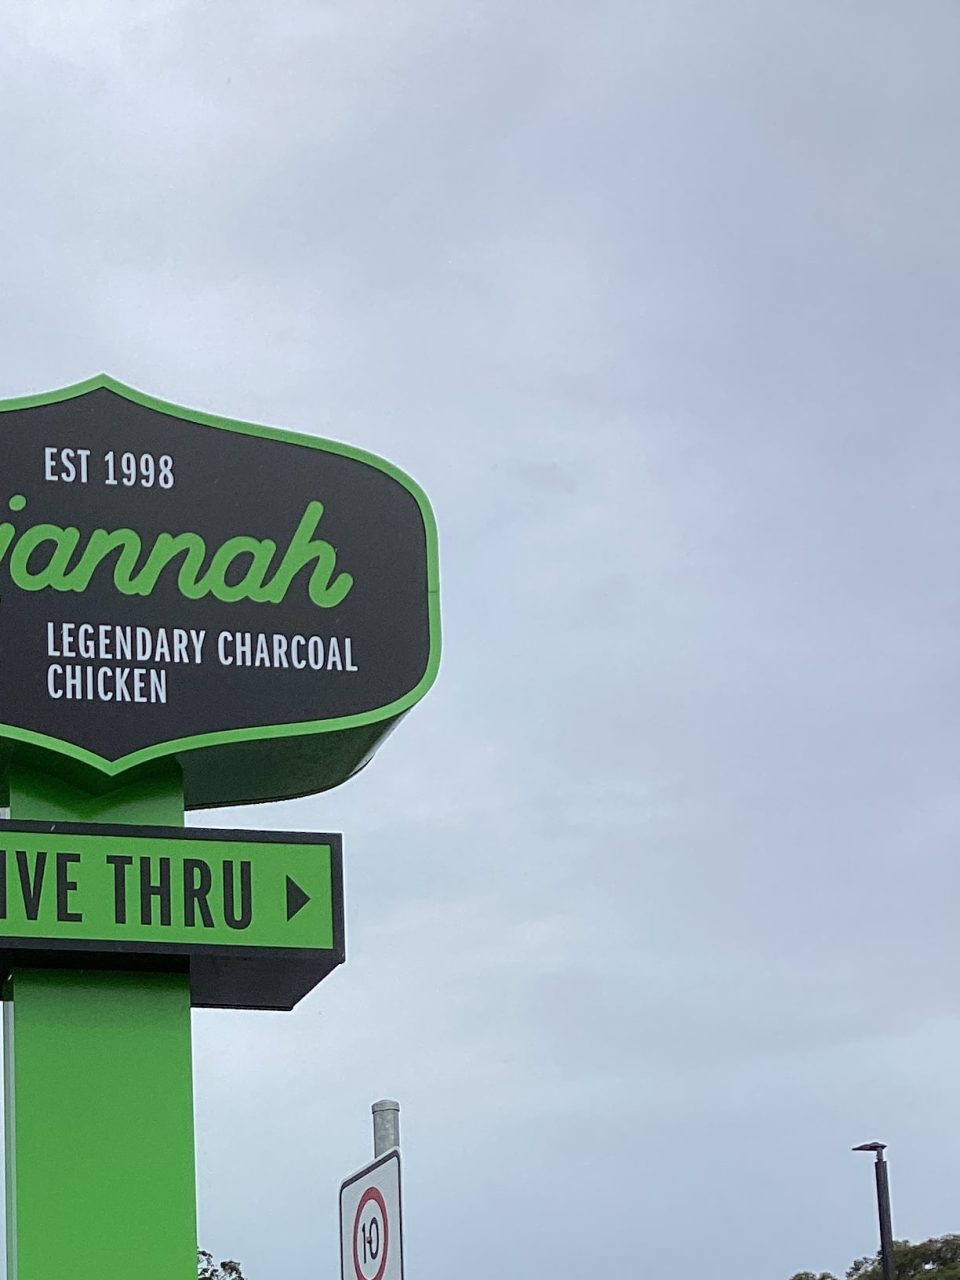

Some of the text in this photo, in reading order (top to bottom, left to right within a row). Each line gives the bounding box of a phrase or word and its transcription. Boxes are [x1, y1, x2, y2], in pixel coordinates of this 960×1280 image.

[44, 447, 174, 489] EST 1998
[47, 621, 359, 672] LEGENDARY CHARCOAL
[47, 663, 167, 704] CHICKEN
[105, 854, 253, 931] THRU
[361, 1216, 380, 1265] 10
